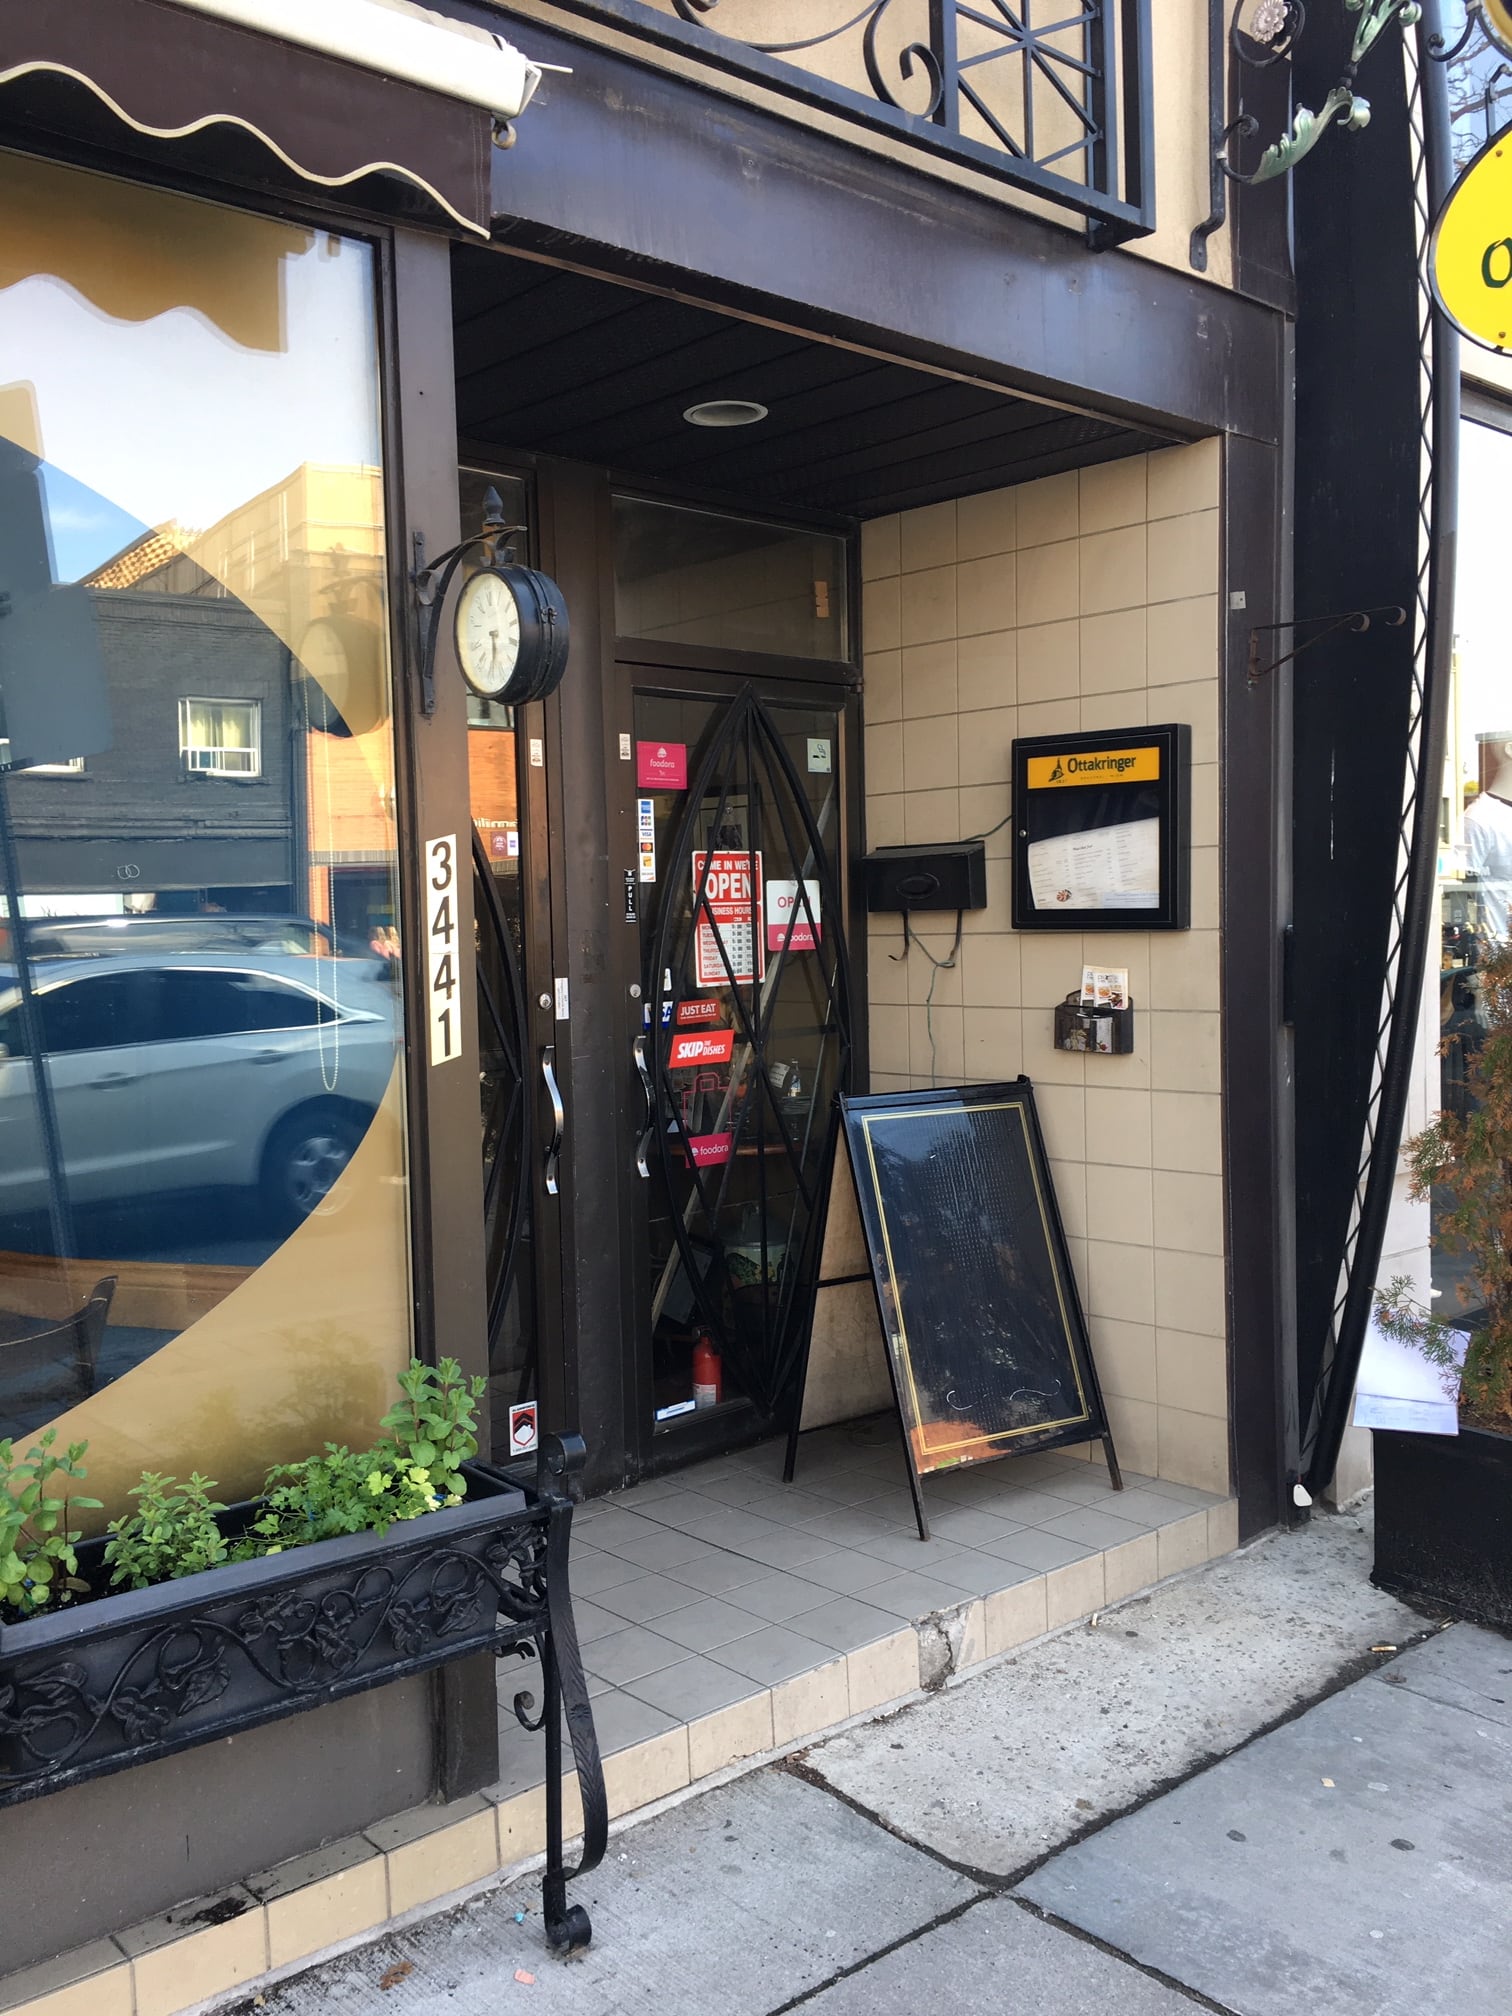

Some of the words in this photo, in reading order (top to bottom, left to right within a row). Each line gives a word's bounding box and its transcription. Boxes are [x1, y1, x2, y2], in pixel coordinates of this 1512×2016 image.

[650, 758, 675, 768] foodora
[1067, 757, 1136, 773] Ottakringer
[697, 860, 722, 870] CME
[723, 860, 733, 870] IN
[705, 872, 752, 899] OPEN
[432, 841, 456, 1057] 3441
[681, 1004, 699, 1016] JUST
[701, 1003, 716, 1014] EAT
[677, 1041, 704, 1059] SKIP
[703, 1045, 725, 1056] DISHES
[700, 1144, 729, 1155] foodora
